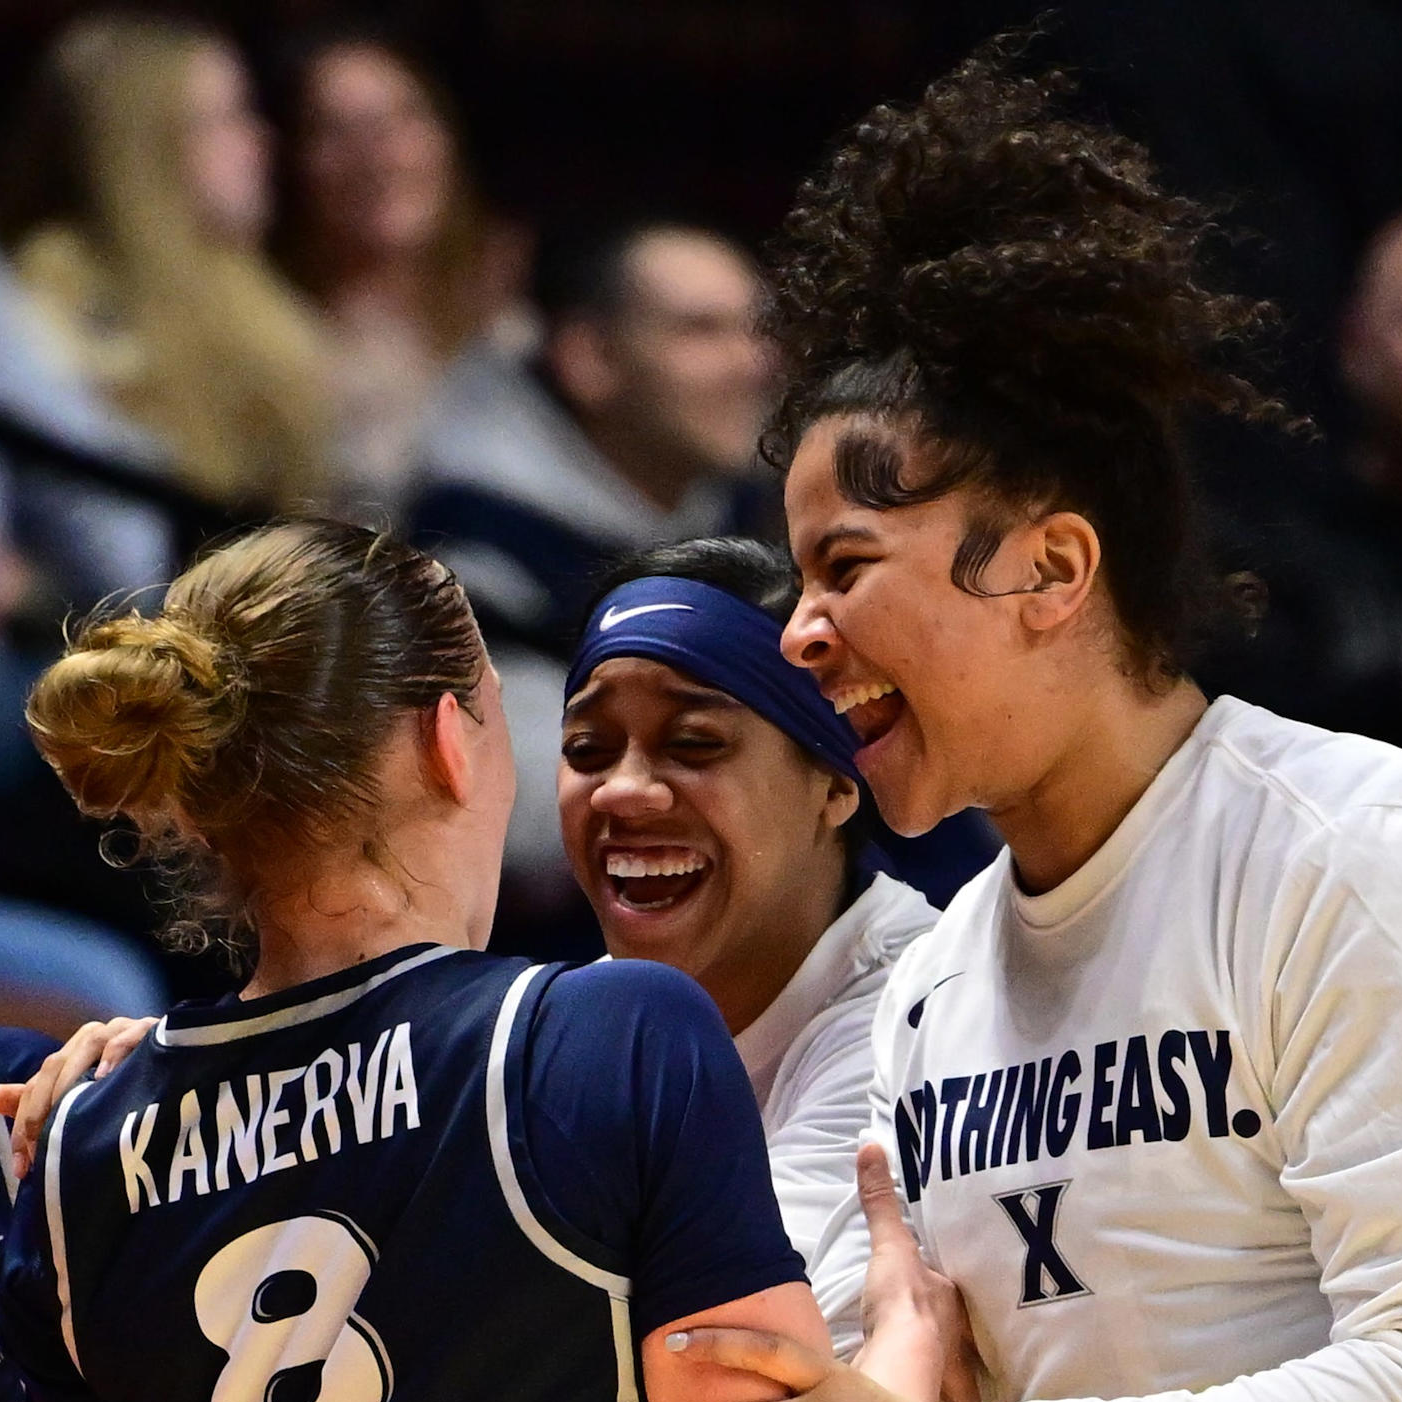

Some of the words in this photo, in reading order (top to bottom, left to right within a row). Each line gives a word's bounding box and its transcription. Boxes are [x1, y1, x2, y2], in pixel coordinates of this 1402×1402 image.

[120, 1021, 421, 1214] KANERVA
[1087, 1029, 1262, 1150] EASY.
[991, 1179, 1095, 1309] X
